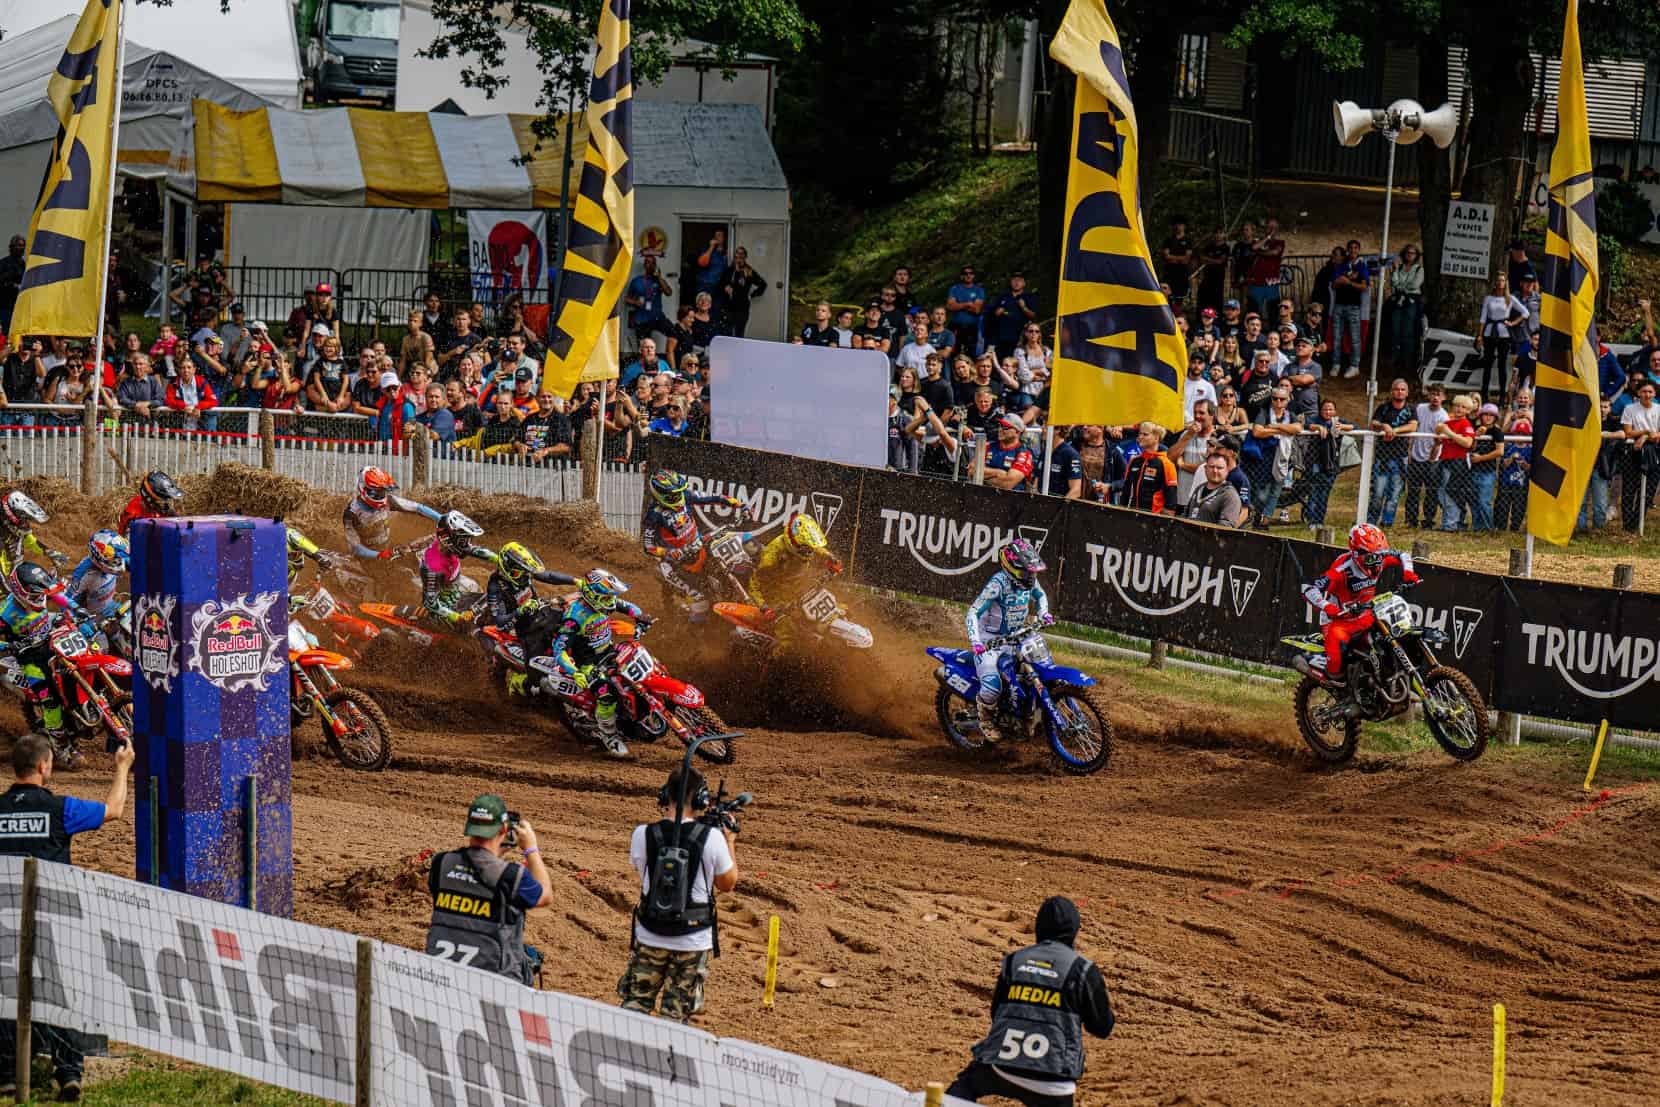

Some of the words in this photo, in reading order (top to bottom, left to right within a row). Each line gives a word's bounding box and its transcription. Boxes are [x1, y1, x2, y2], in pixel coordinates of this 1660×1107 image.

[678, 474, 808, 537] RIUMPH
[880, 508, 1014, 575] TRIUMPH
[1086, 543, 1224, 615] TRIUMPH
[60, 635, 87, 656] 96
[211, 653, 261, 676] HOLESHOT
[628, 656, 652, 682] 911
[559, 681, 578, 695] 911
[0, 818, 44, 833] CREW
[436, 892, 492, 918] MEDIA
[435, 940, 480, 967] 27
[1007, 984, 1062, 1008] MEDIA
[998, 1028, 1050, 1060] 50
